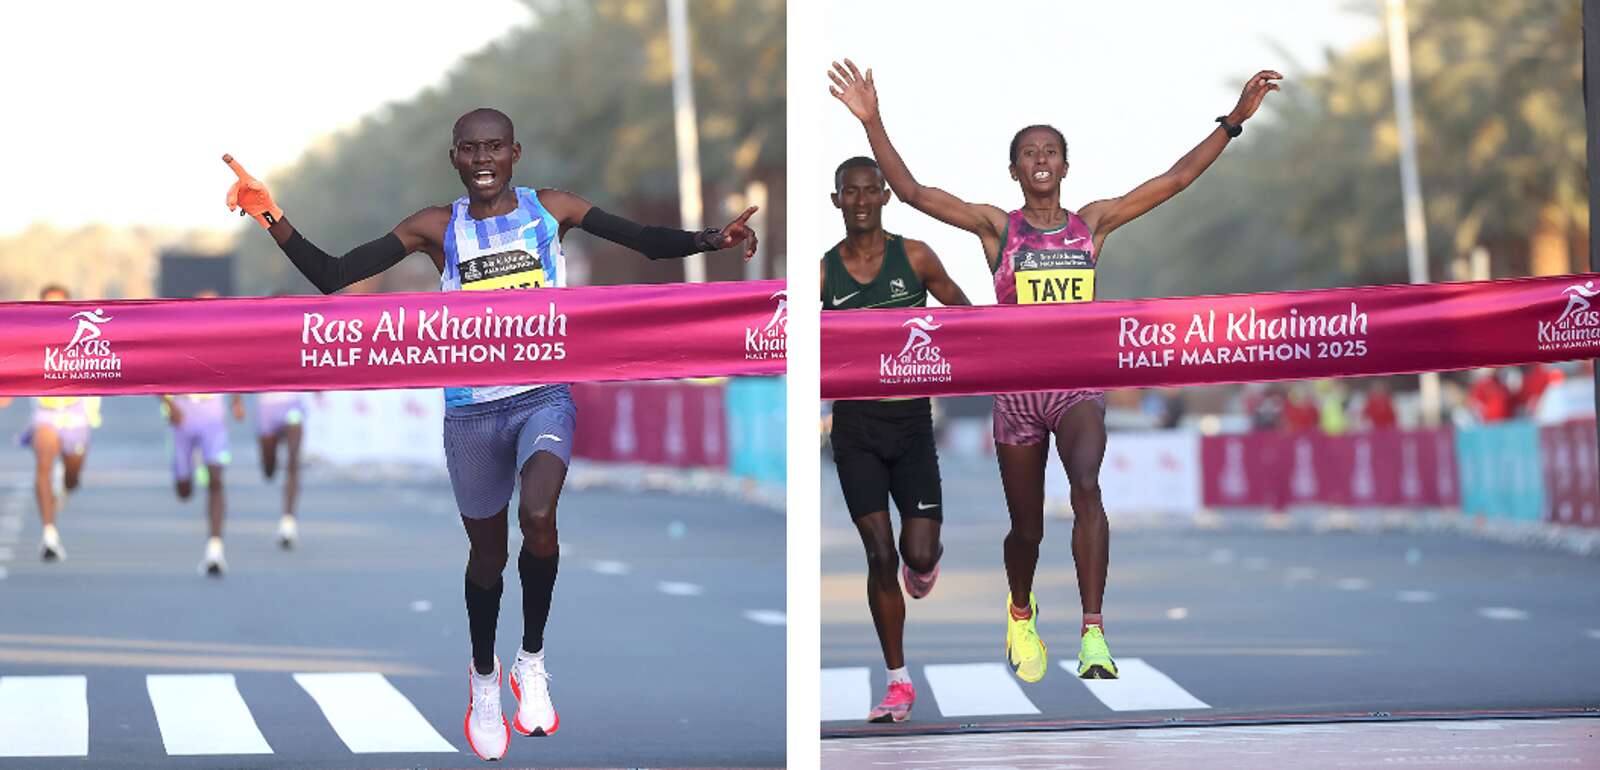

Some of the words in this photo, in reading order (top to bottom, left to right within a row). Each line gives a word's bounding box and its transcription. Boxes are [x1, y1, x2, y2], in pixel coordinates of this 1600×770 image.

[1028, 278, 1083, 302] TAYE
[302, 312, 363, 345] Ras
[372, 306, 405, 342] Al
[417, 302, 567, 341] Khaimah
[1118, 317, 1176, 347] Ras
[1184, 309, 1215, 344] Al
[1226, 302, 1367, 342] Khaimah
[67, 345, 79, 358] al
[745, 327, 786, 352] Khai
[44, 347, 121, 371] Khaimah
[301, 348, 362, 368] HALF
[368, 343, 505, 366] MARATHON
[513, 342, 567, 361] 2025
[880, 354, 951, 376] Khaimah
[1118, 349, 1175, 369] HALF
[1181, 343, 1310, 366] MARATHON
[1317, 340, 1367, 359] 2025
